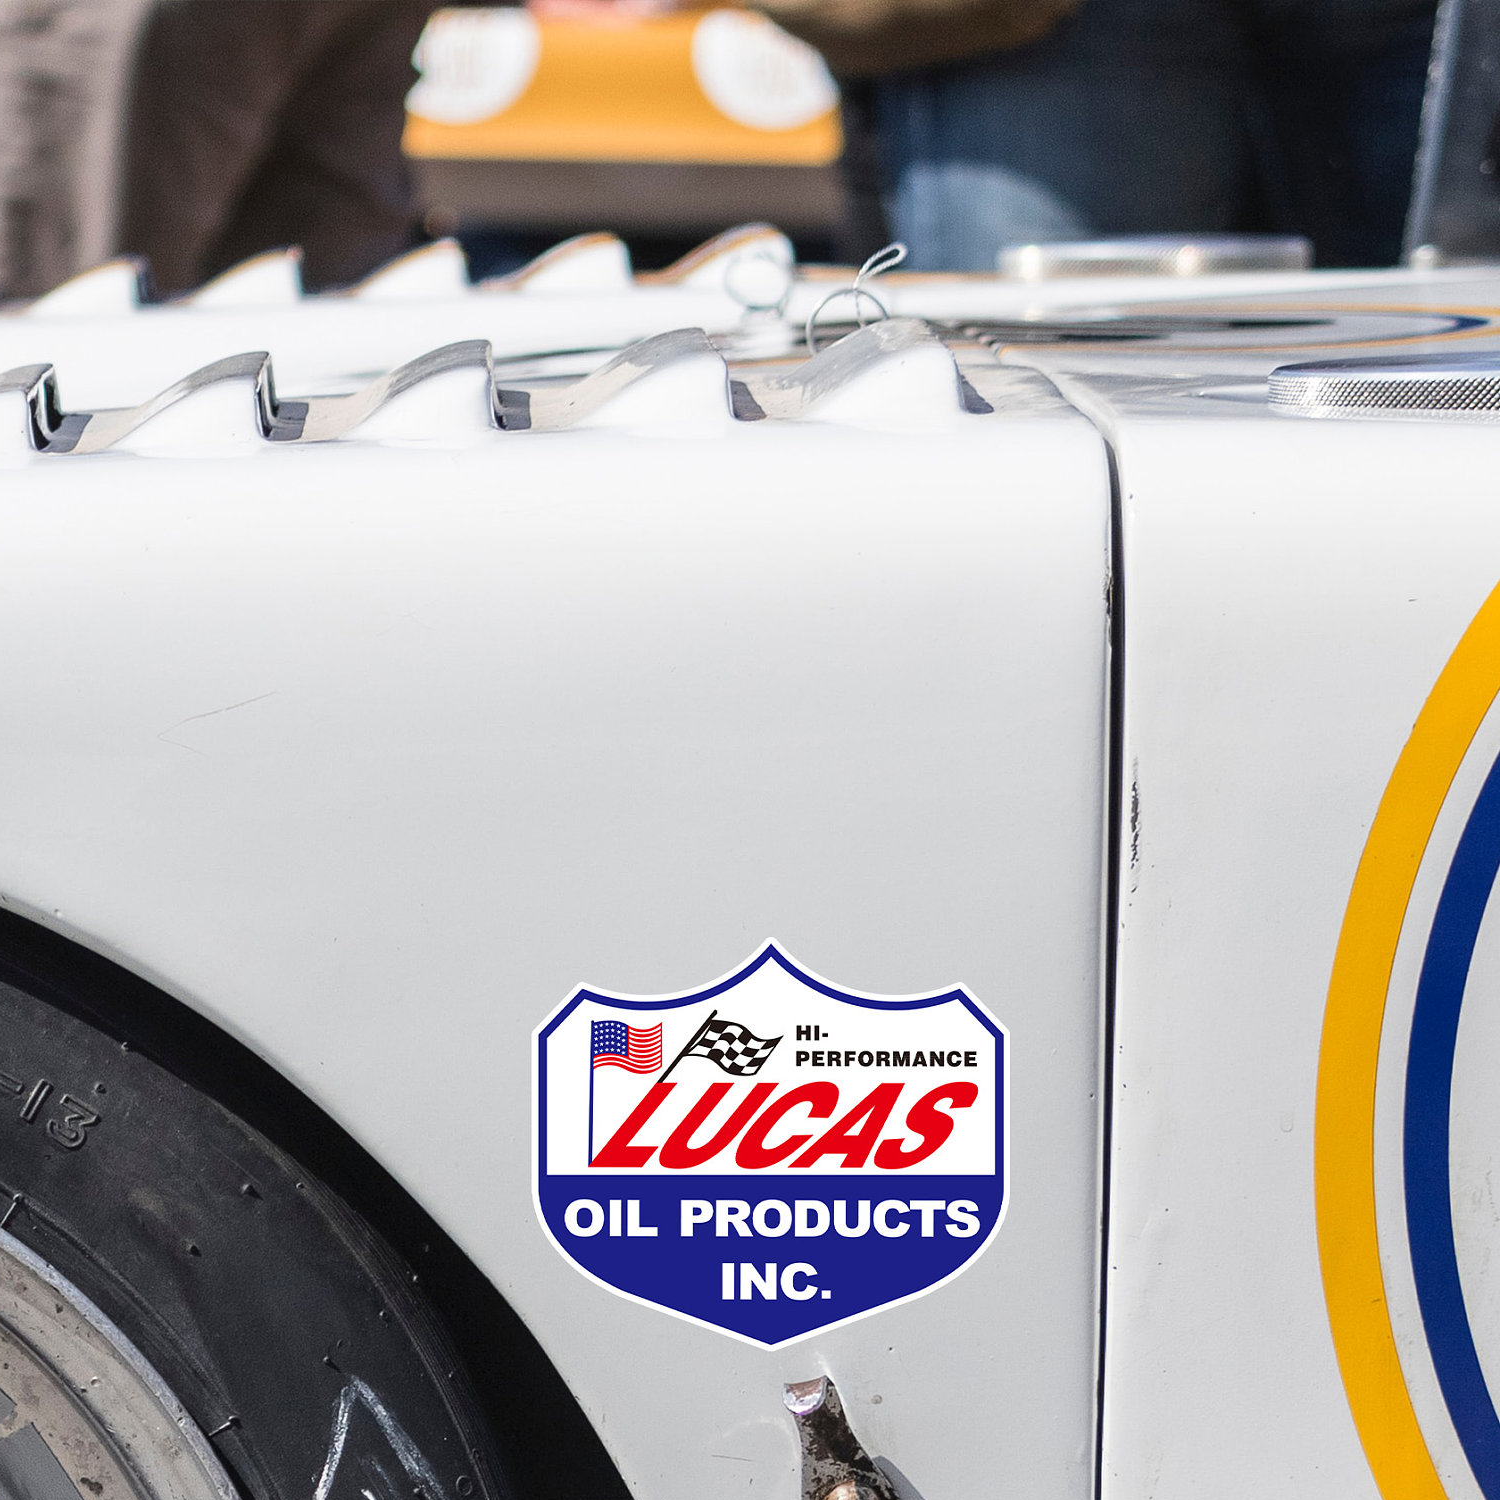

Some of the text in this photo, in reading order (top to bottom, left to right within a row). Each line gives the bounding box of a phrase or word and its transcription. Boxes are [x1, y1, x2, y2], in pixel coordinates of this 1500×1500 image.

[795, 1025, 830, 1042] HI-
[795, 1050, 979, 1068] PERFORMANCE
[588, 1081, 979, 1169] LUCAS
[563, 1198, 981, 1238] OIL PRODUCTS
[721, 1262, 832, 1301] INC.
